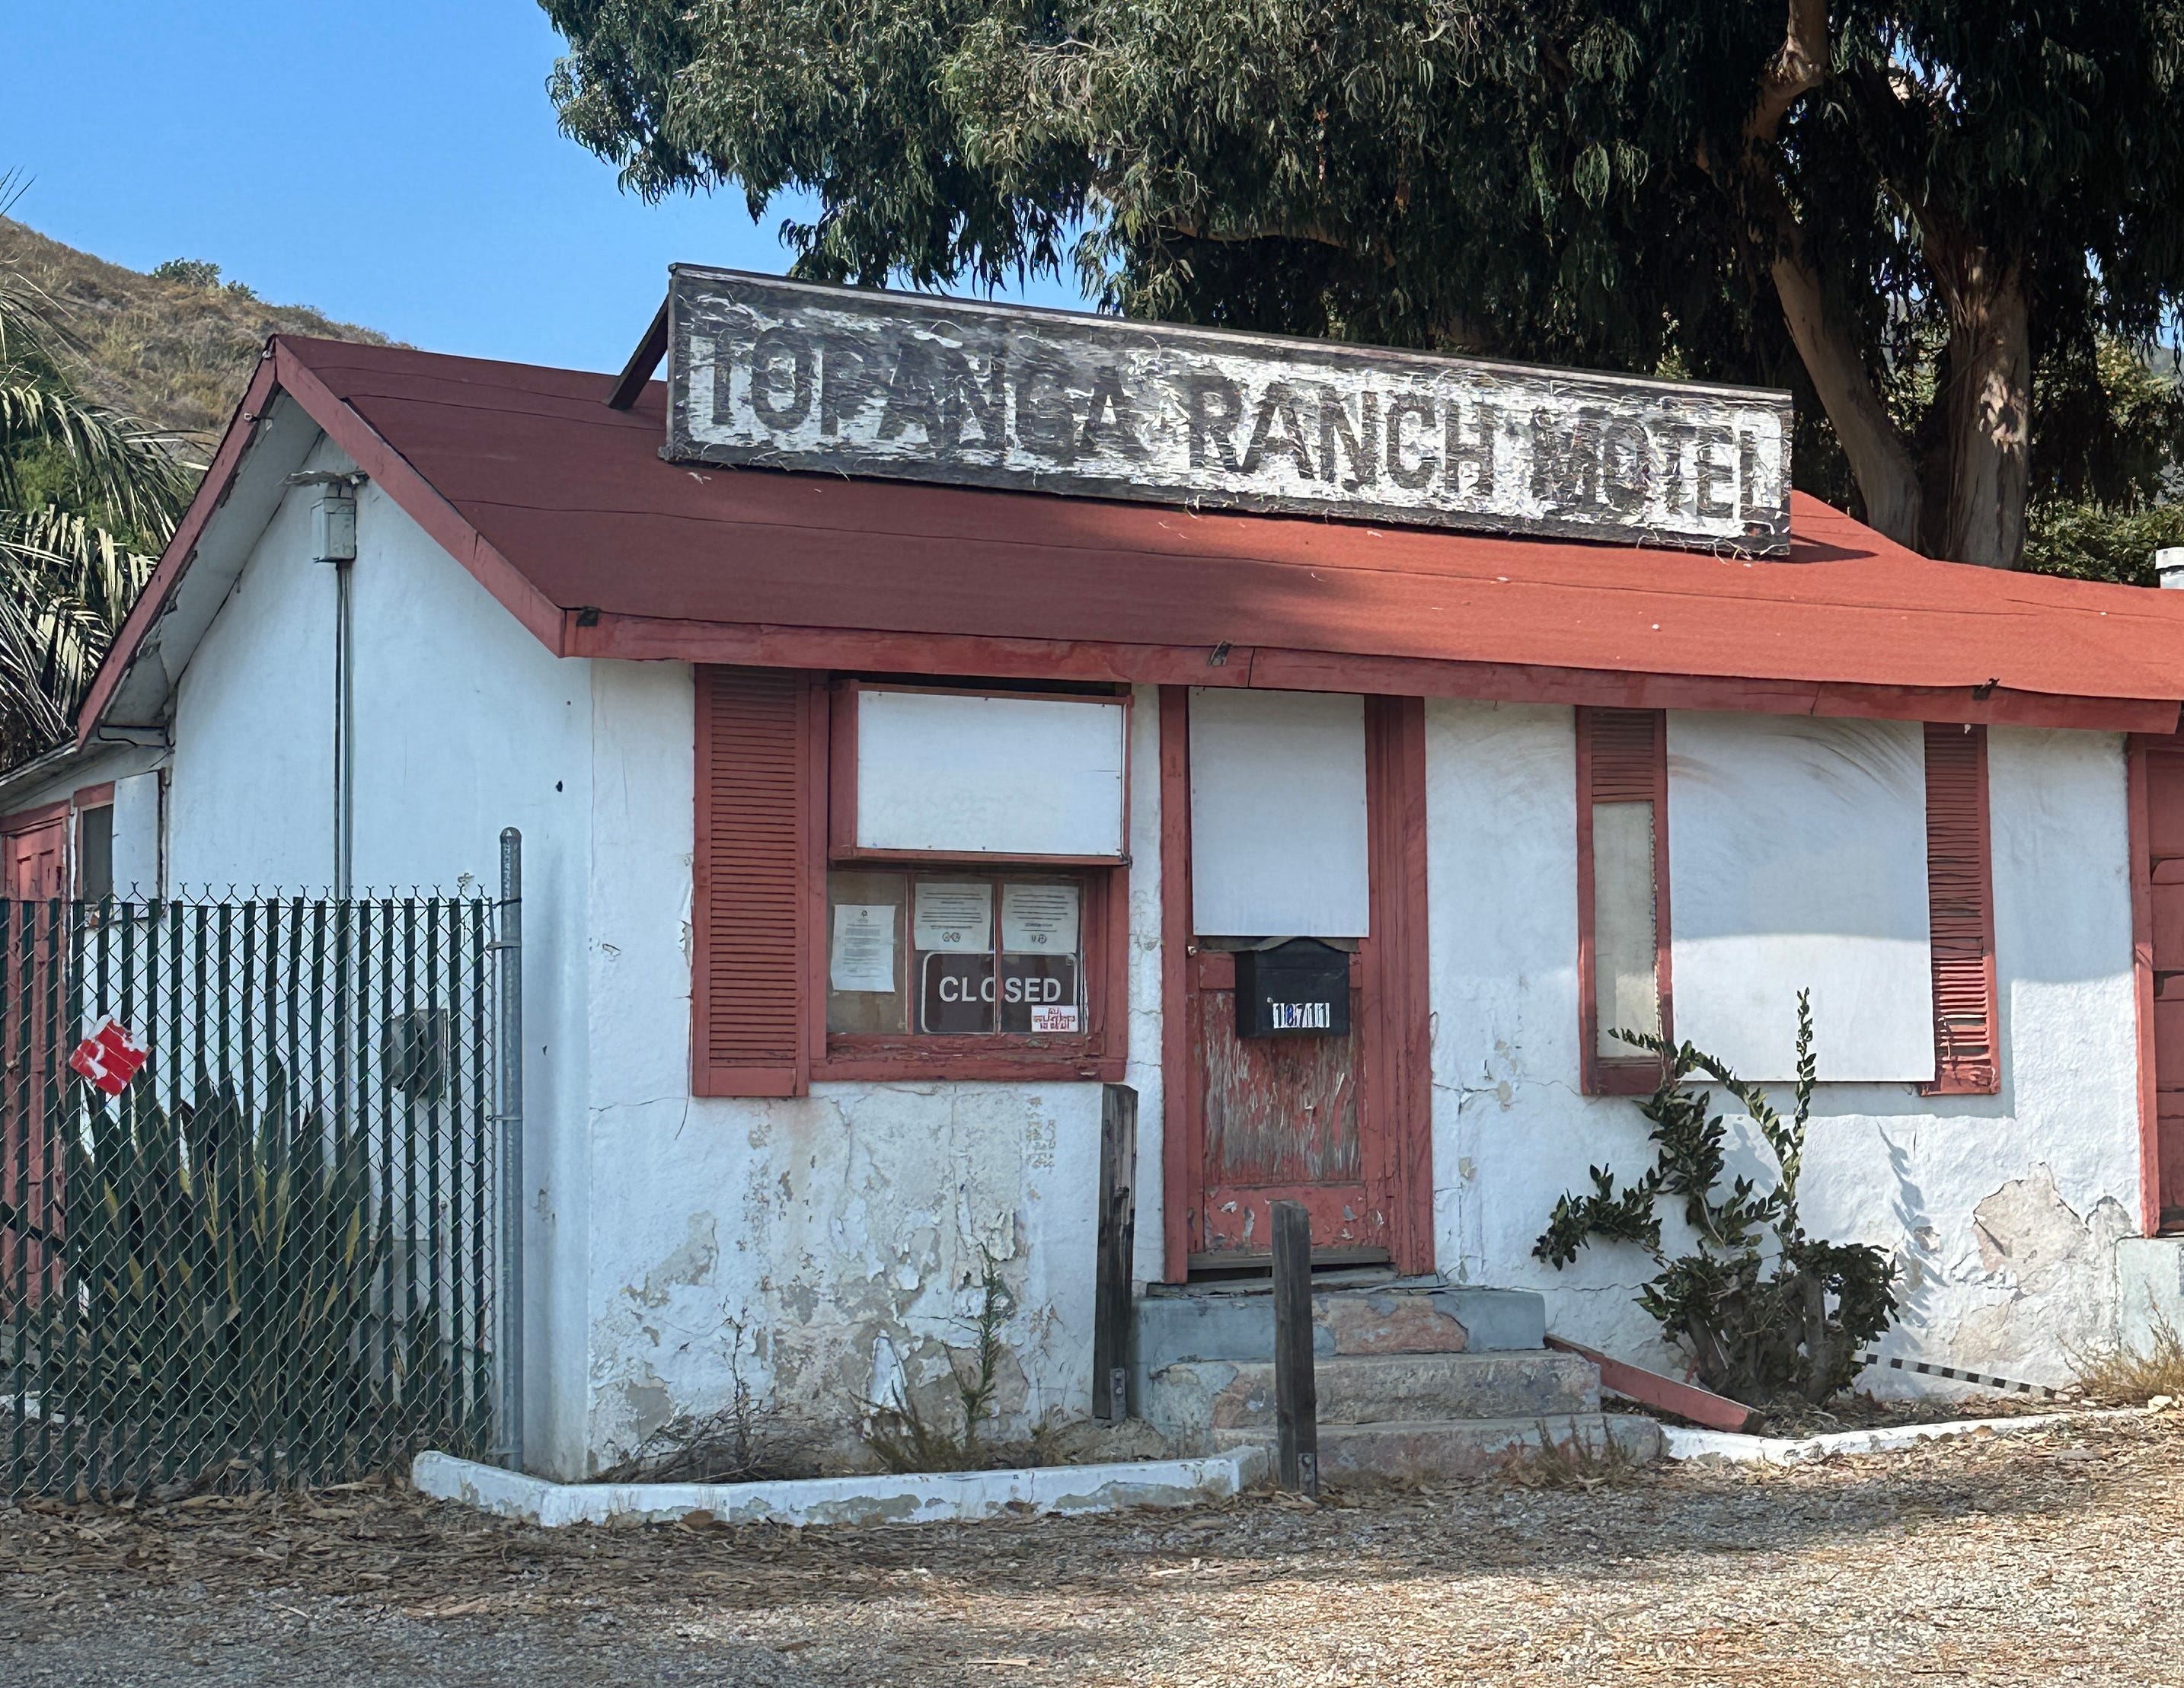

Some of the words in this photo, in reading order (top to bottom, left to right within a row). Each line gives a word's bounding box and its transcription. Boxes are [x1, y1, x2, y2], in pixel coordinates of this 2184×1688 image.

[1188, 375, 1493, 493] RANCH
[1529, 407, 1777, 524] MOTEL
[939, 976, 1062, 1003] CLOSED
